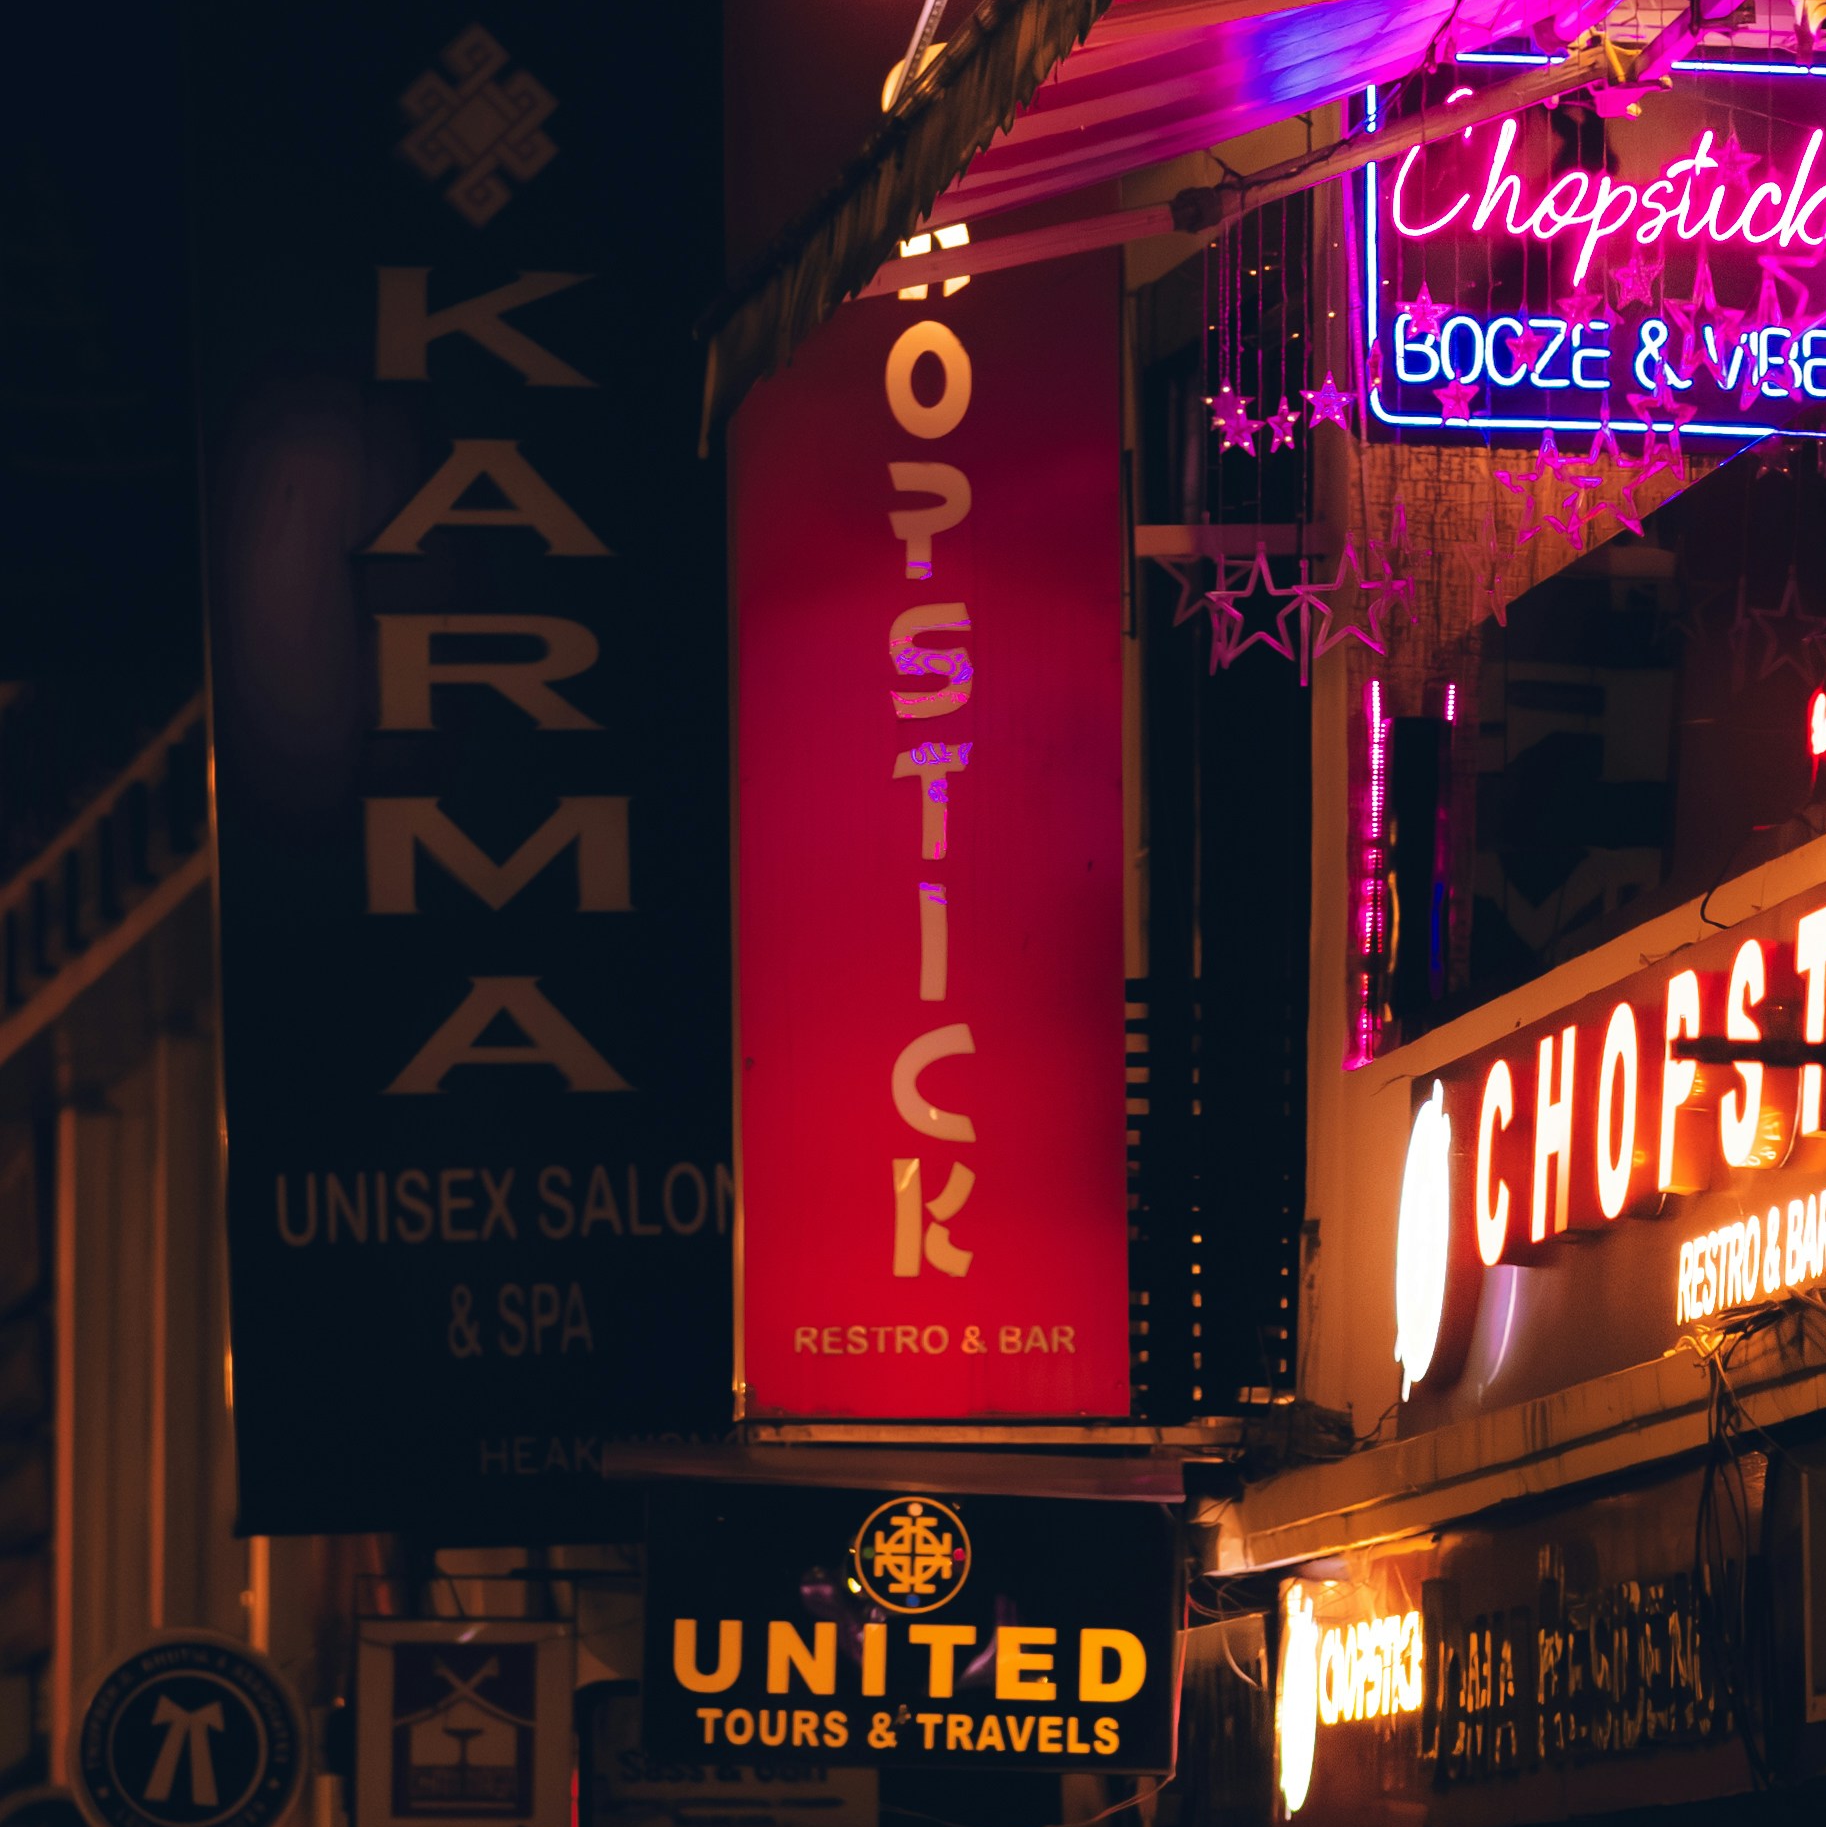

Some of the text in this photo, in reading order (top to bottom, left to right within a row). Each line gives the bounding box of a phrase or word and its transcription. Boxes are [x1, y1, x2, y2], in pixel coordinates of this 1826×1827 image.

[1393, 311, 1613, 390] BOOZE
[1633, 318, 1695, 390] &
[360, 265, 641, 1095] KARMA
[274, 1166, 520, 1247] UNISEX
[1676, 1214, 1761, 1327] RESTRO
[1762, 1205, 1782, 1294] &
[446, 1280, 596, 1360] & SPA
[794, 1325, 1077, 1356] RESTRO & BAR
[671, 1617, 1149, 1703] UNITED
[696, 1707, 1121, 1757] TOURS & TRAVELS
